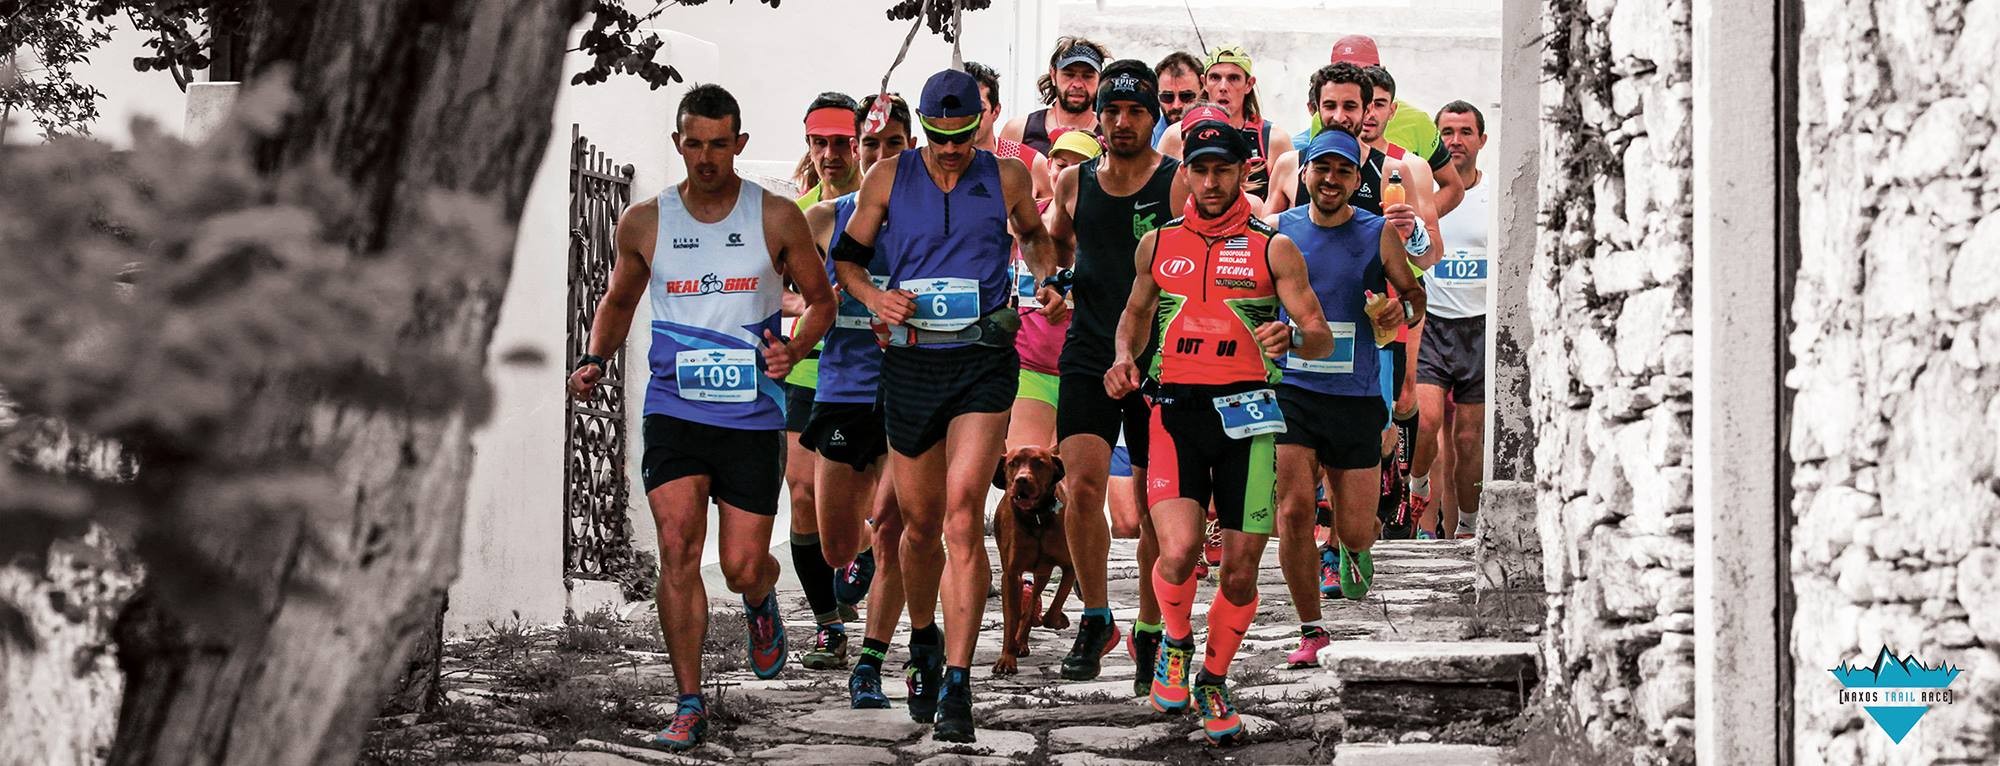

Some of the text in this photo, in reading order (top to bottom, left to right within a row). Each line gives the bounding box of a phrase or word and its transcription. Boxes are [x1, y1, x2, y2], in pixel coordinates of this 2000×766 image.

[1216, 266, 1254, 276] TECNICA
[1445, 261, 1478, 278] 102
[666, 277, 759, 293] REAL BIKE
[932, 294, 948, 317] 6
[1176, 337, 1204, 354] OUT
[694, 366, 741, 388] 109
[1246, 403, 1264, 420] 8
